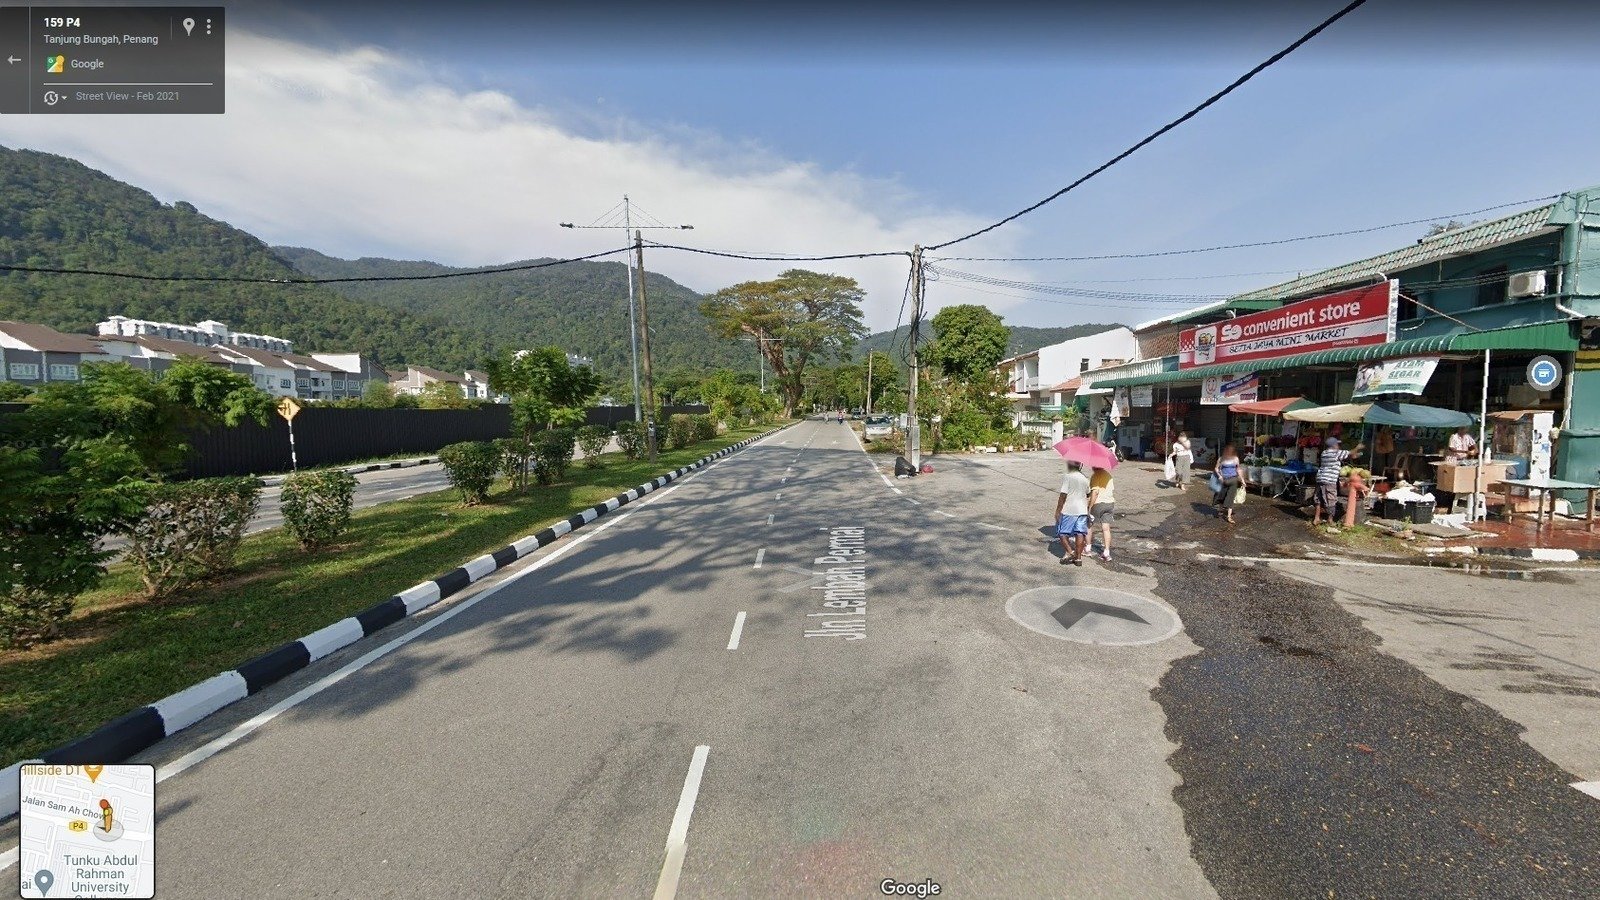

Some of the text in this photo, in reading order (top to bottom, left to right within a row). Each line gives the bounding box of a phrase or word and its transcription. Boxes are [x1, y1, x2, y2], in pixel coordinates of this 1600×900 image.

[1243, 308, 1315, 336] convenient
[1318, 301, 1360, 323] store
[1275, 334, 1303, 347] MINI
[1304, 327, 1350, 342] MARKET
[1388, 370, 1422, 379] SEGAR
